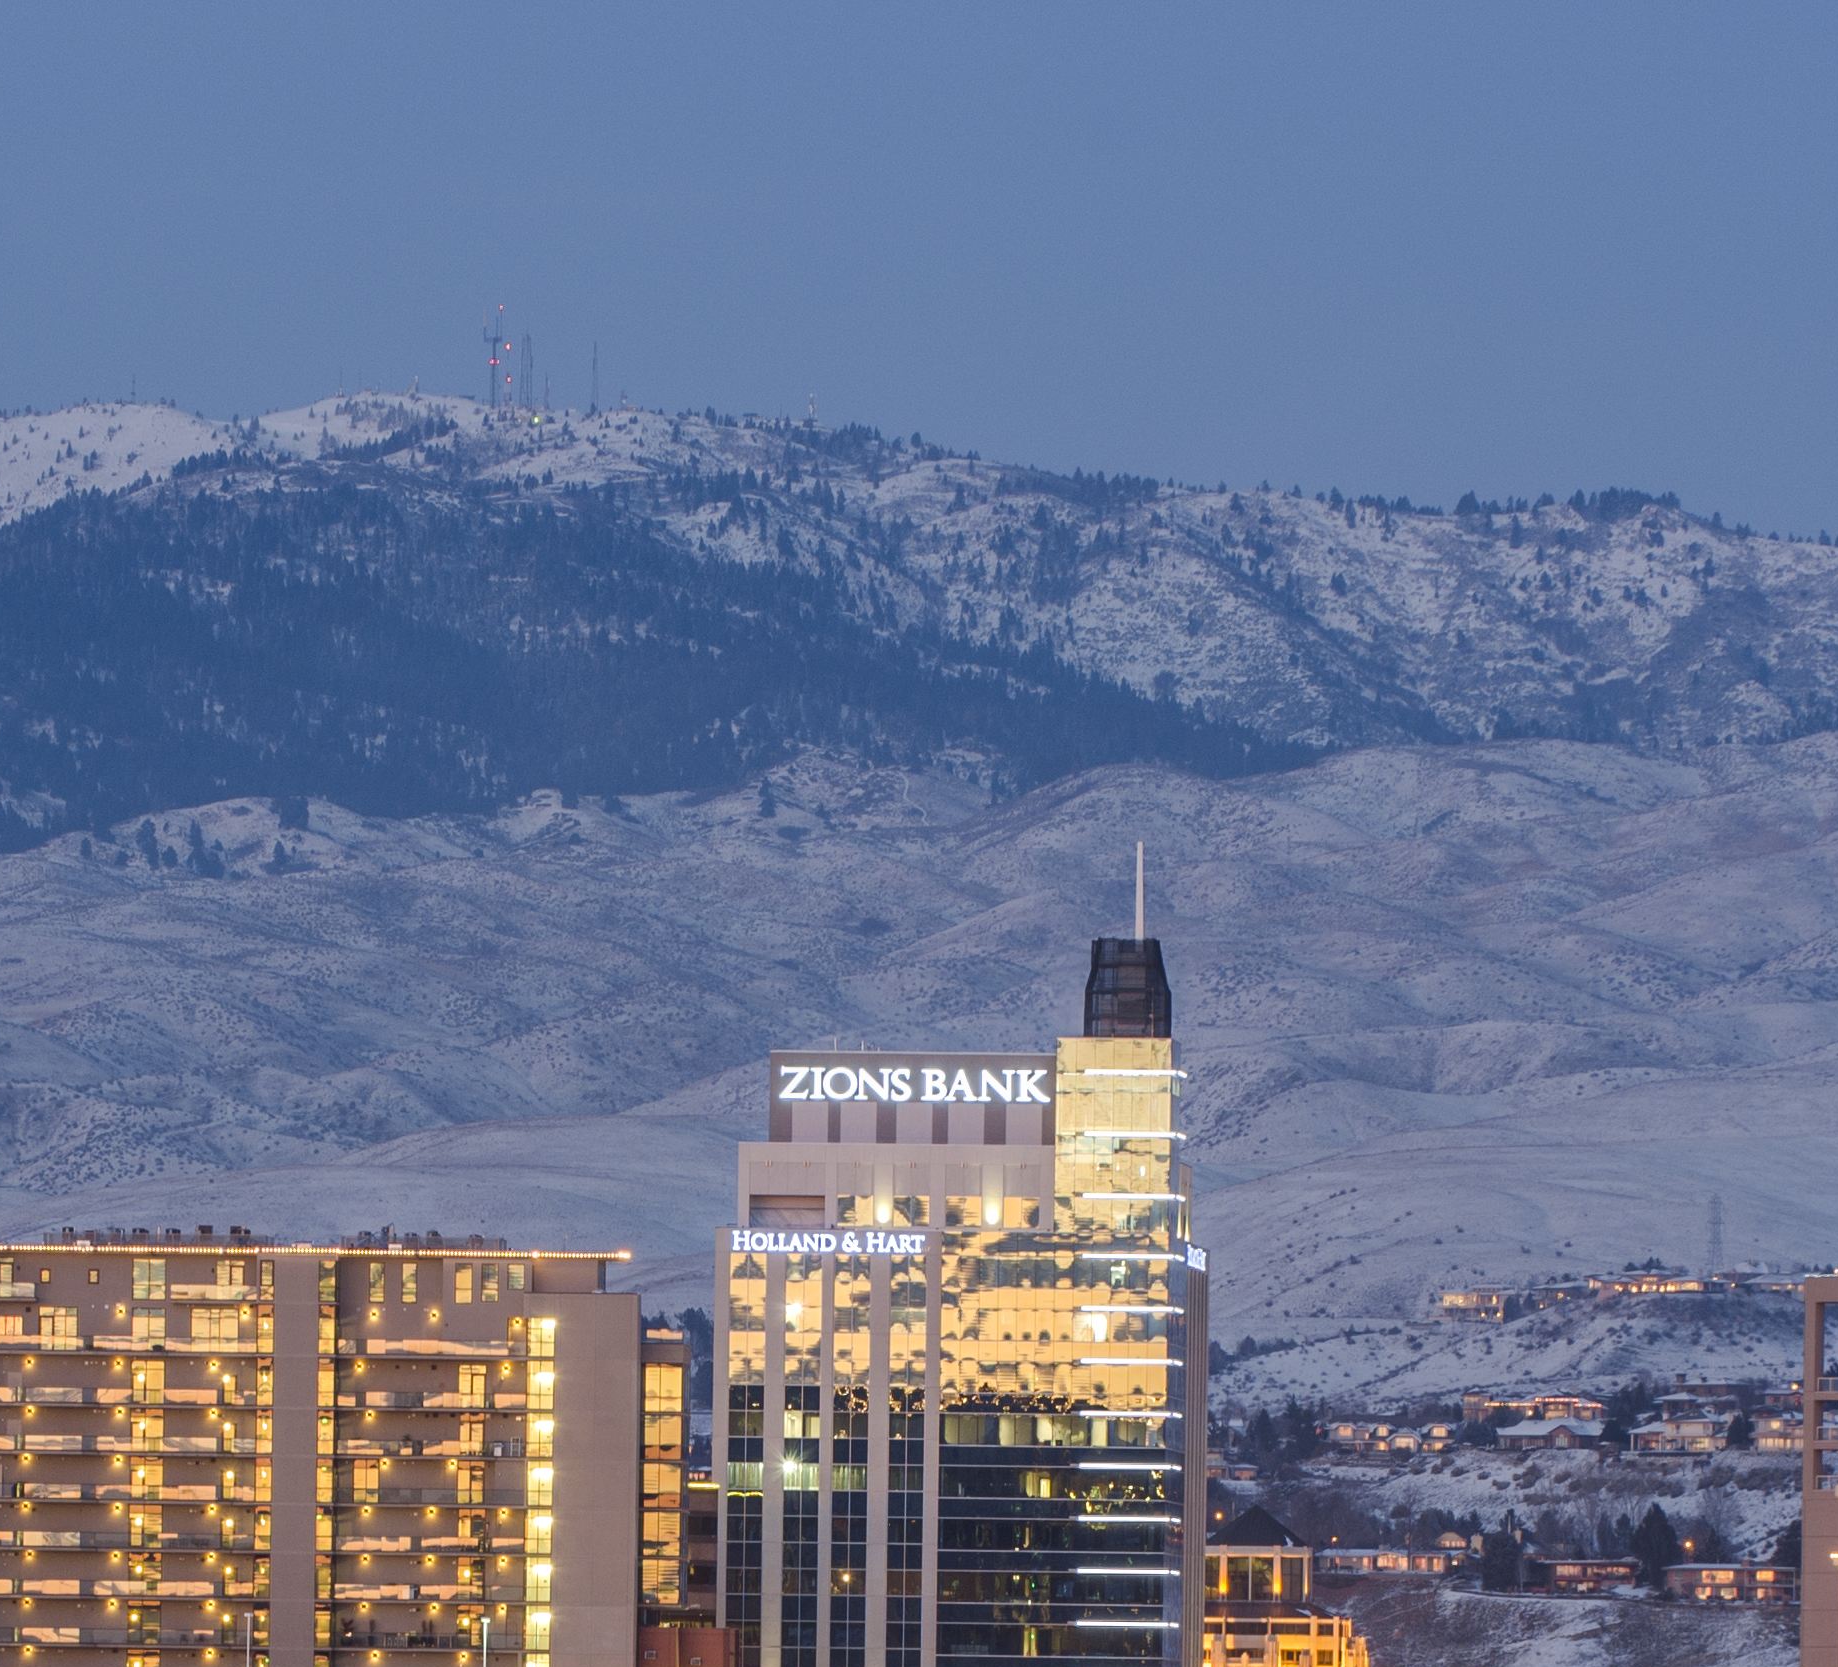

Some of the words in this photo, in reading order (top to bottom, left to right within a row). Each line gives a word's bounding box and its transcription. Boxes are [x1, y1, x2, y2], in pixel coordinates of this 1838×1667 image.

[779, 1065, 912, 1101] ZIONS
[920, 1068, 1051, 1102] BANK
[842, 1231, 862, 1253] &
